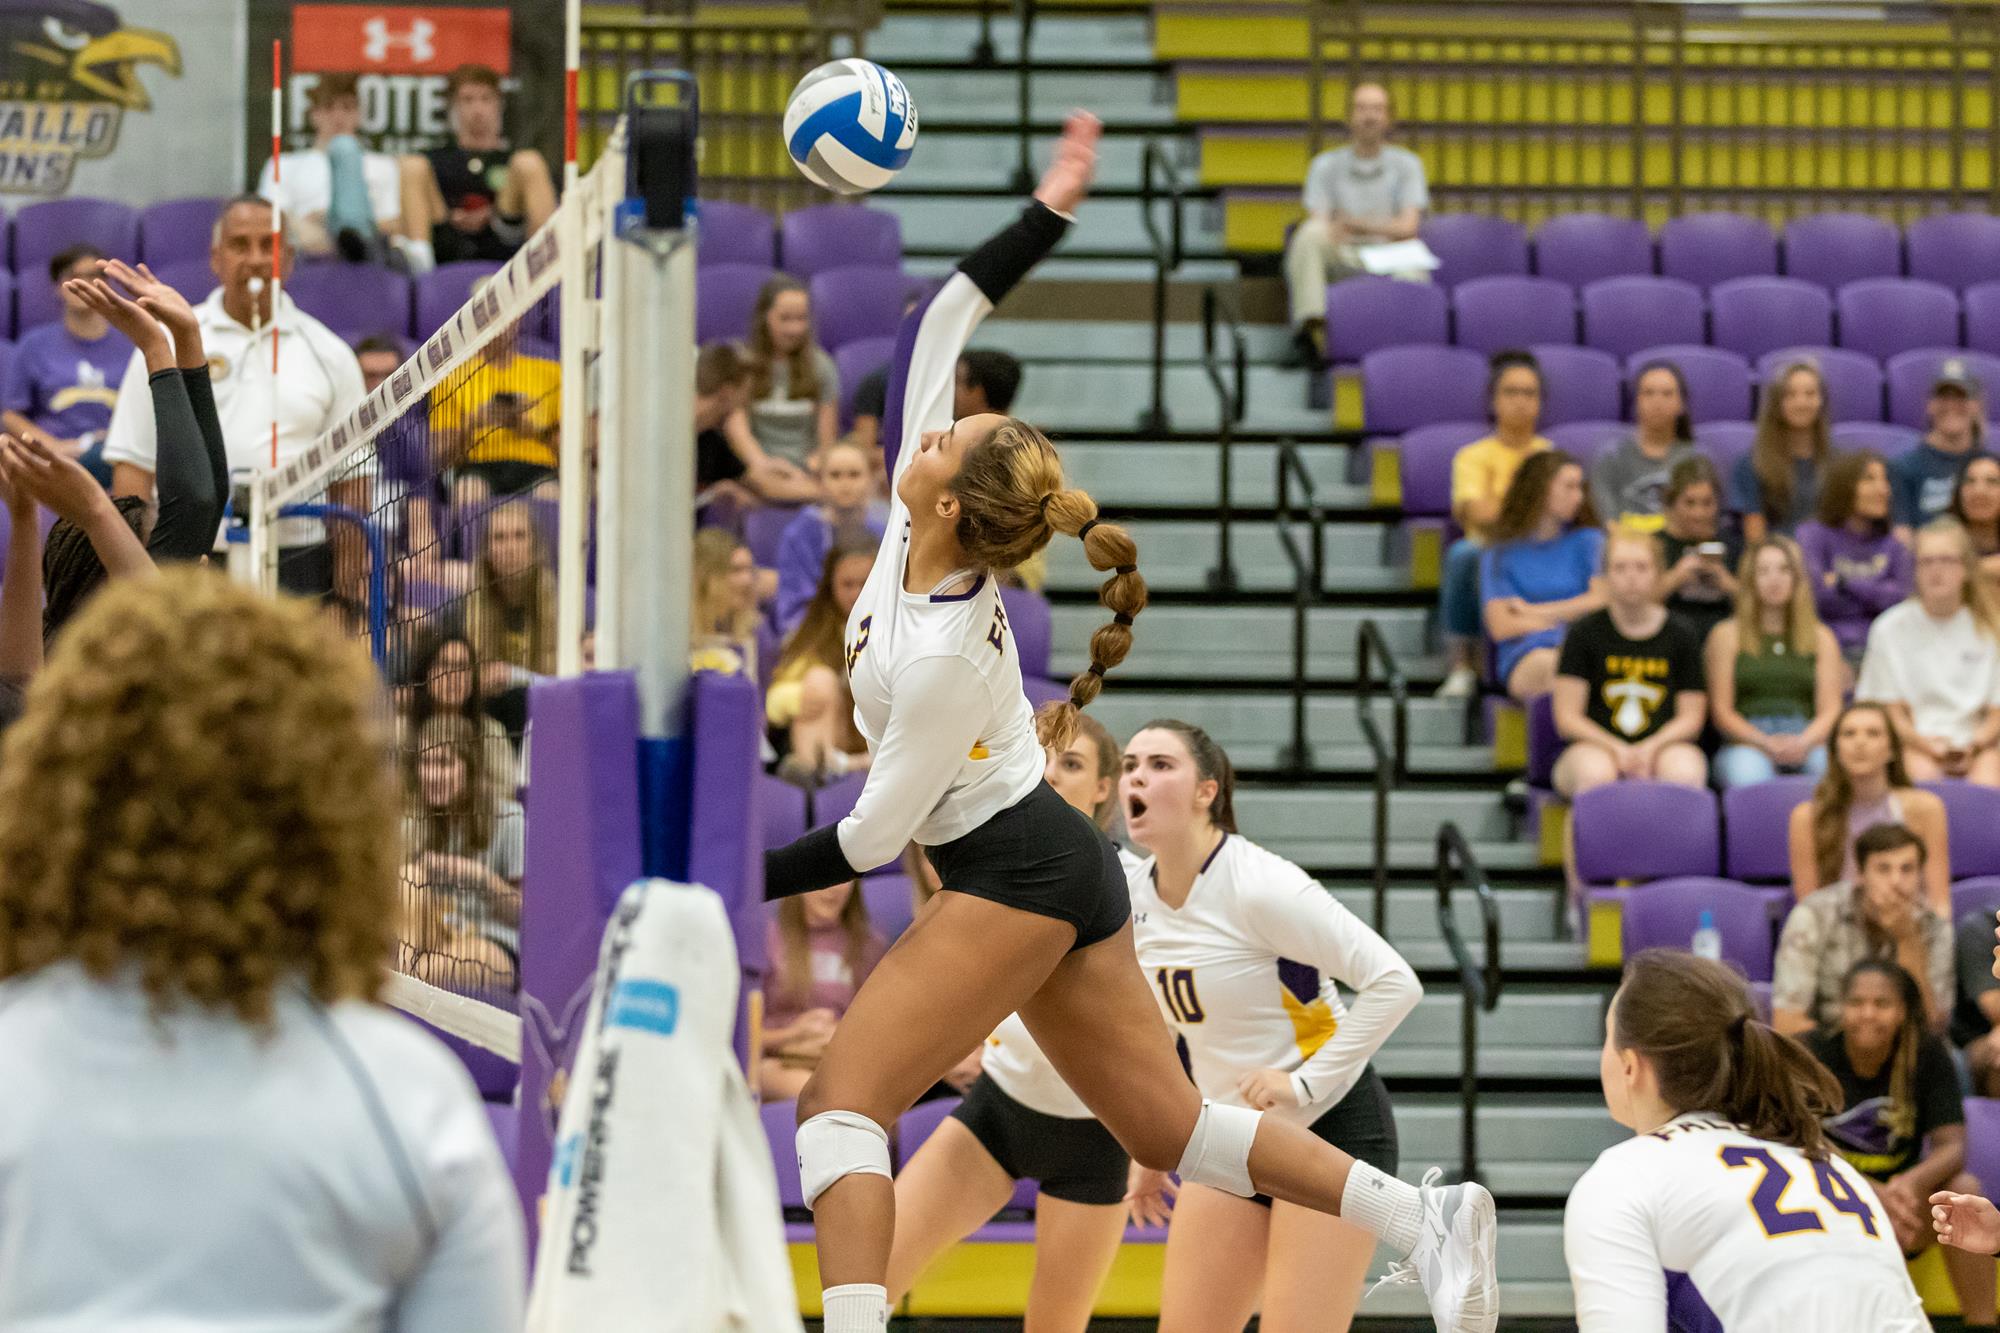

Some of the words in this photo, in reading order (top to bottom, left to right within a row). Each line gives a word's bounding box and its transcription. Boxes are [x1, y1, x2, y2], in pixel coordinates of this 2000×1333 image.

[0, 106, 112, 147] ALLO
[1157, 967, 1205, 1024] 10
[1718, 1144, 1880, 1239] 24
